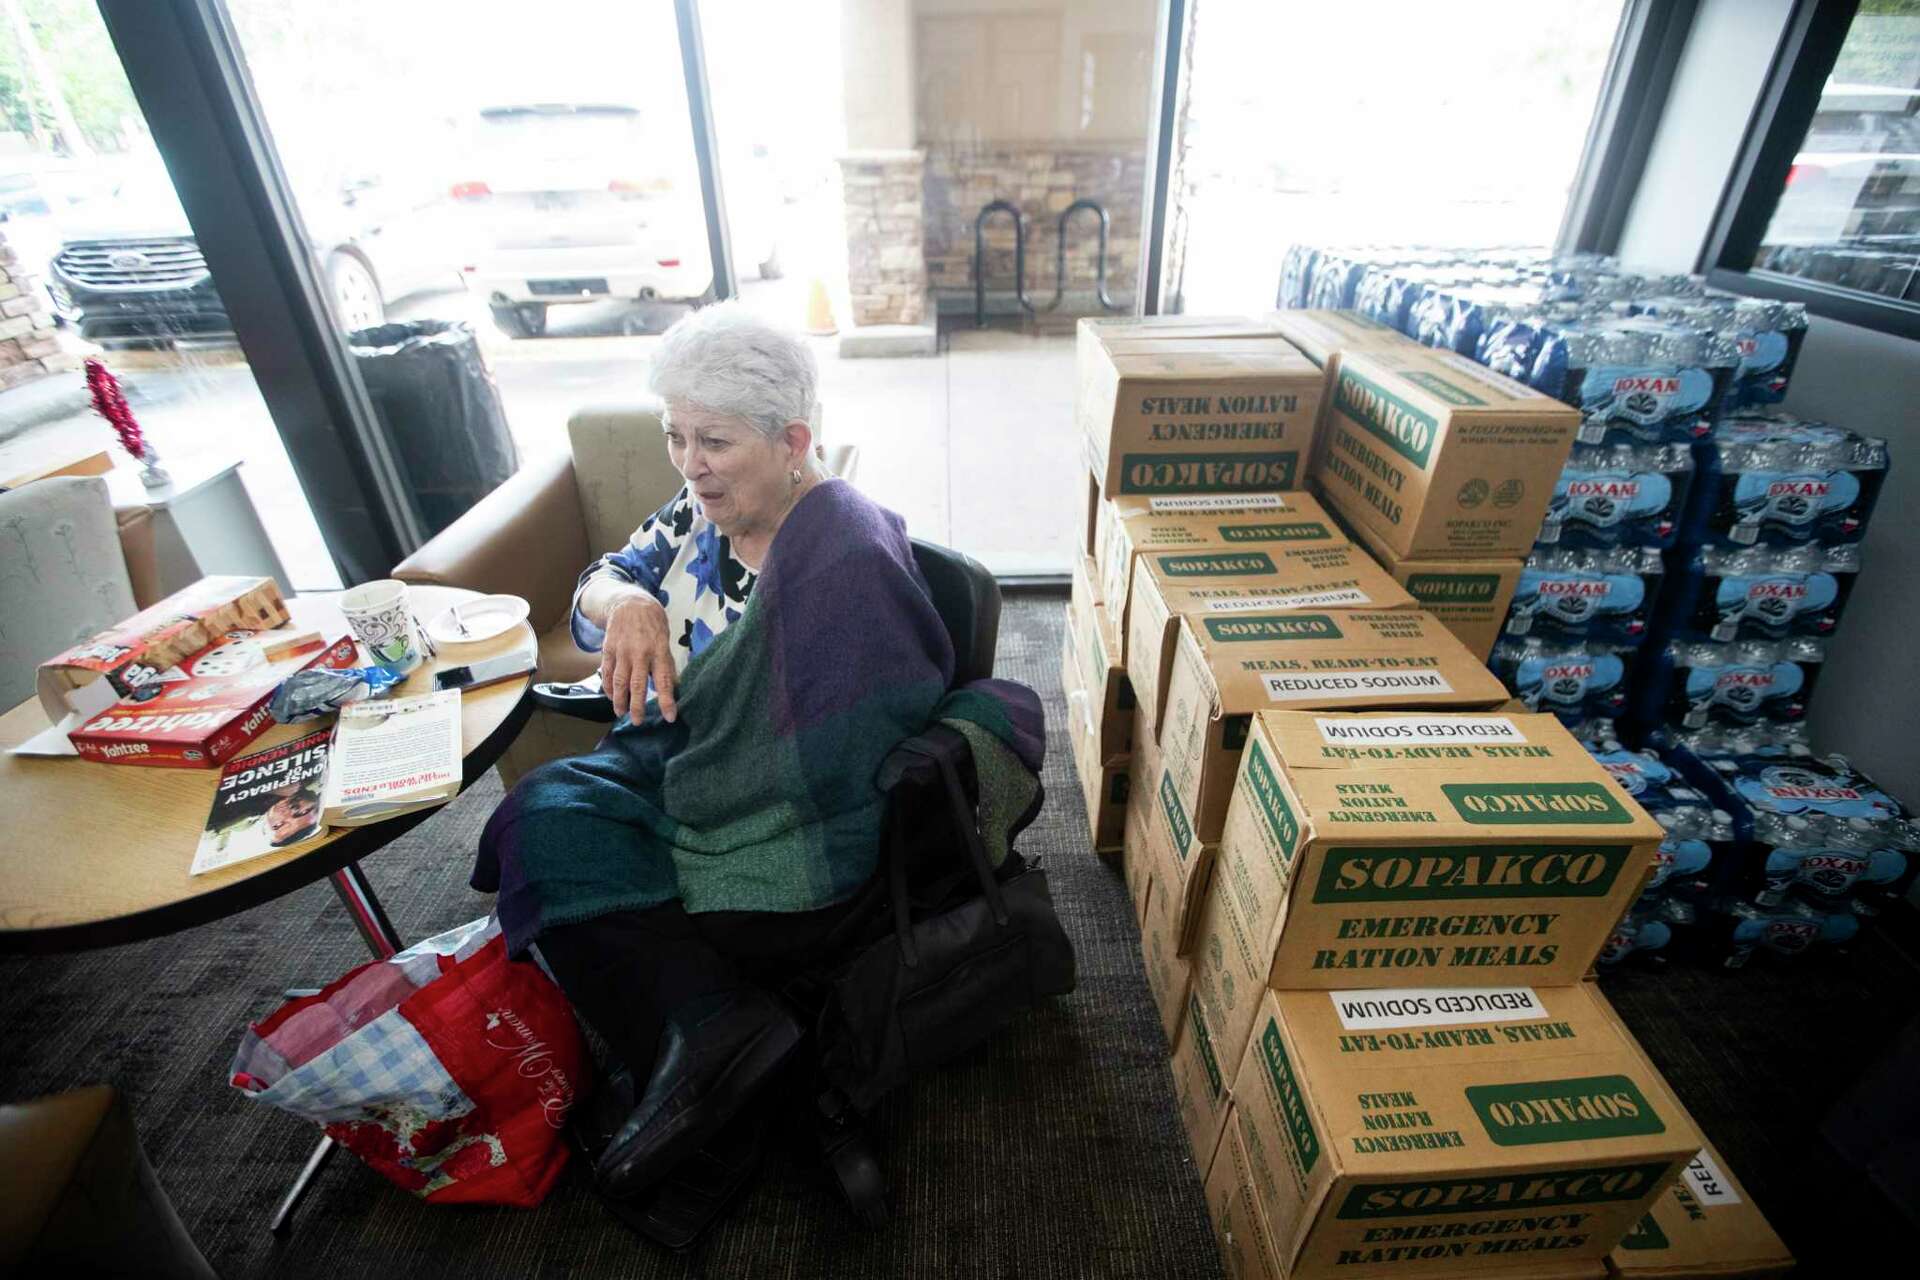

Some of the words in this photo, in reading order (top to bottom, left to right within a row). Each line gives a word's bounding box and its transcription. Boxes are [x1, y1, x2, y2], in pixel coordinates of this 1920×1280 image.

[1141, 397, 1210, 415] MEALS
[1218, 395, 1298, 414] RATION
[1342, 376, 1429, 453] SOPAKCO
[1149, 422, 1285, 441] EMERGENCY
[1336, 428, 1407, 493] EMERGENCY
[1131, 462, 1289, 487] SOPAKCO
[1229, 526, 1320, 539] SOPAKCO
[1169, 557, 1265, 572] SOPAKCO
[1218, 621, 1328, 636] SOPAKCO
[1241, 659, 1308, 672] MEALS,
[1312, 656, 1440, 670] READY-TO-EAT
[1270, 677, 1359, 692] REDUCED
[1361, 675, 1441, 688] SODIUM
[1326, 725, 1413, 738] SODIUM
[1417, 724, 1513, 737] REDUCED
[100, 743, 150, 759] Yahtzee
[1321, 746, 1473, 760] READY-TO-EAT
[1475, 745, 1554, 757] MEALS,
[220, 743, 328, 791] SILENCE
[1336, 784, 1394, 794] MEALS
[1251, 755, 1292, 844] SOPAKCO
[1340, 797, 1408, 808] RATION
[1463, 794, 1609, 812] SOPAKCO
[1328, 811, 1437, 823] EMERGENCY
[1335, 853, 1607, 890] SOPAKCO
[1337, 914, 1561, 939] EMERGENCY
[1312, 947, 1444, 969] RATION
[1448, 945, 1559, 967] MEALS
[1342, 998, 1432, 1019] SODIUM
[1435, 992, 1533, 1013] REDUCED
[1339, 1028, 1495, 1052] READY-TO-EAT
[1495, 1022, 1576, 1043] MEALS,
[1267, 1034, 1312, 1153] SOPAKCO
[1358, 1091, 1419, 1109] MEALS
[1490, 1092, 1640, 1128] SOPAKCO
[1362, 1111, 1434, 1130] RATION
[1352, 1131, 1466, 1153] EMERGENCY
[1363, 1170, 1643, 1211] SOPAKCO
[1361, 1213, 1592, 1243] EMERGENCY
[1336, 1243, 1471, 1265] RATION
[1474, 1233, 1591, 1255] MEALS
